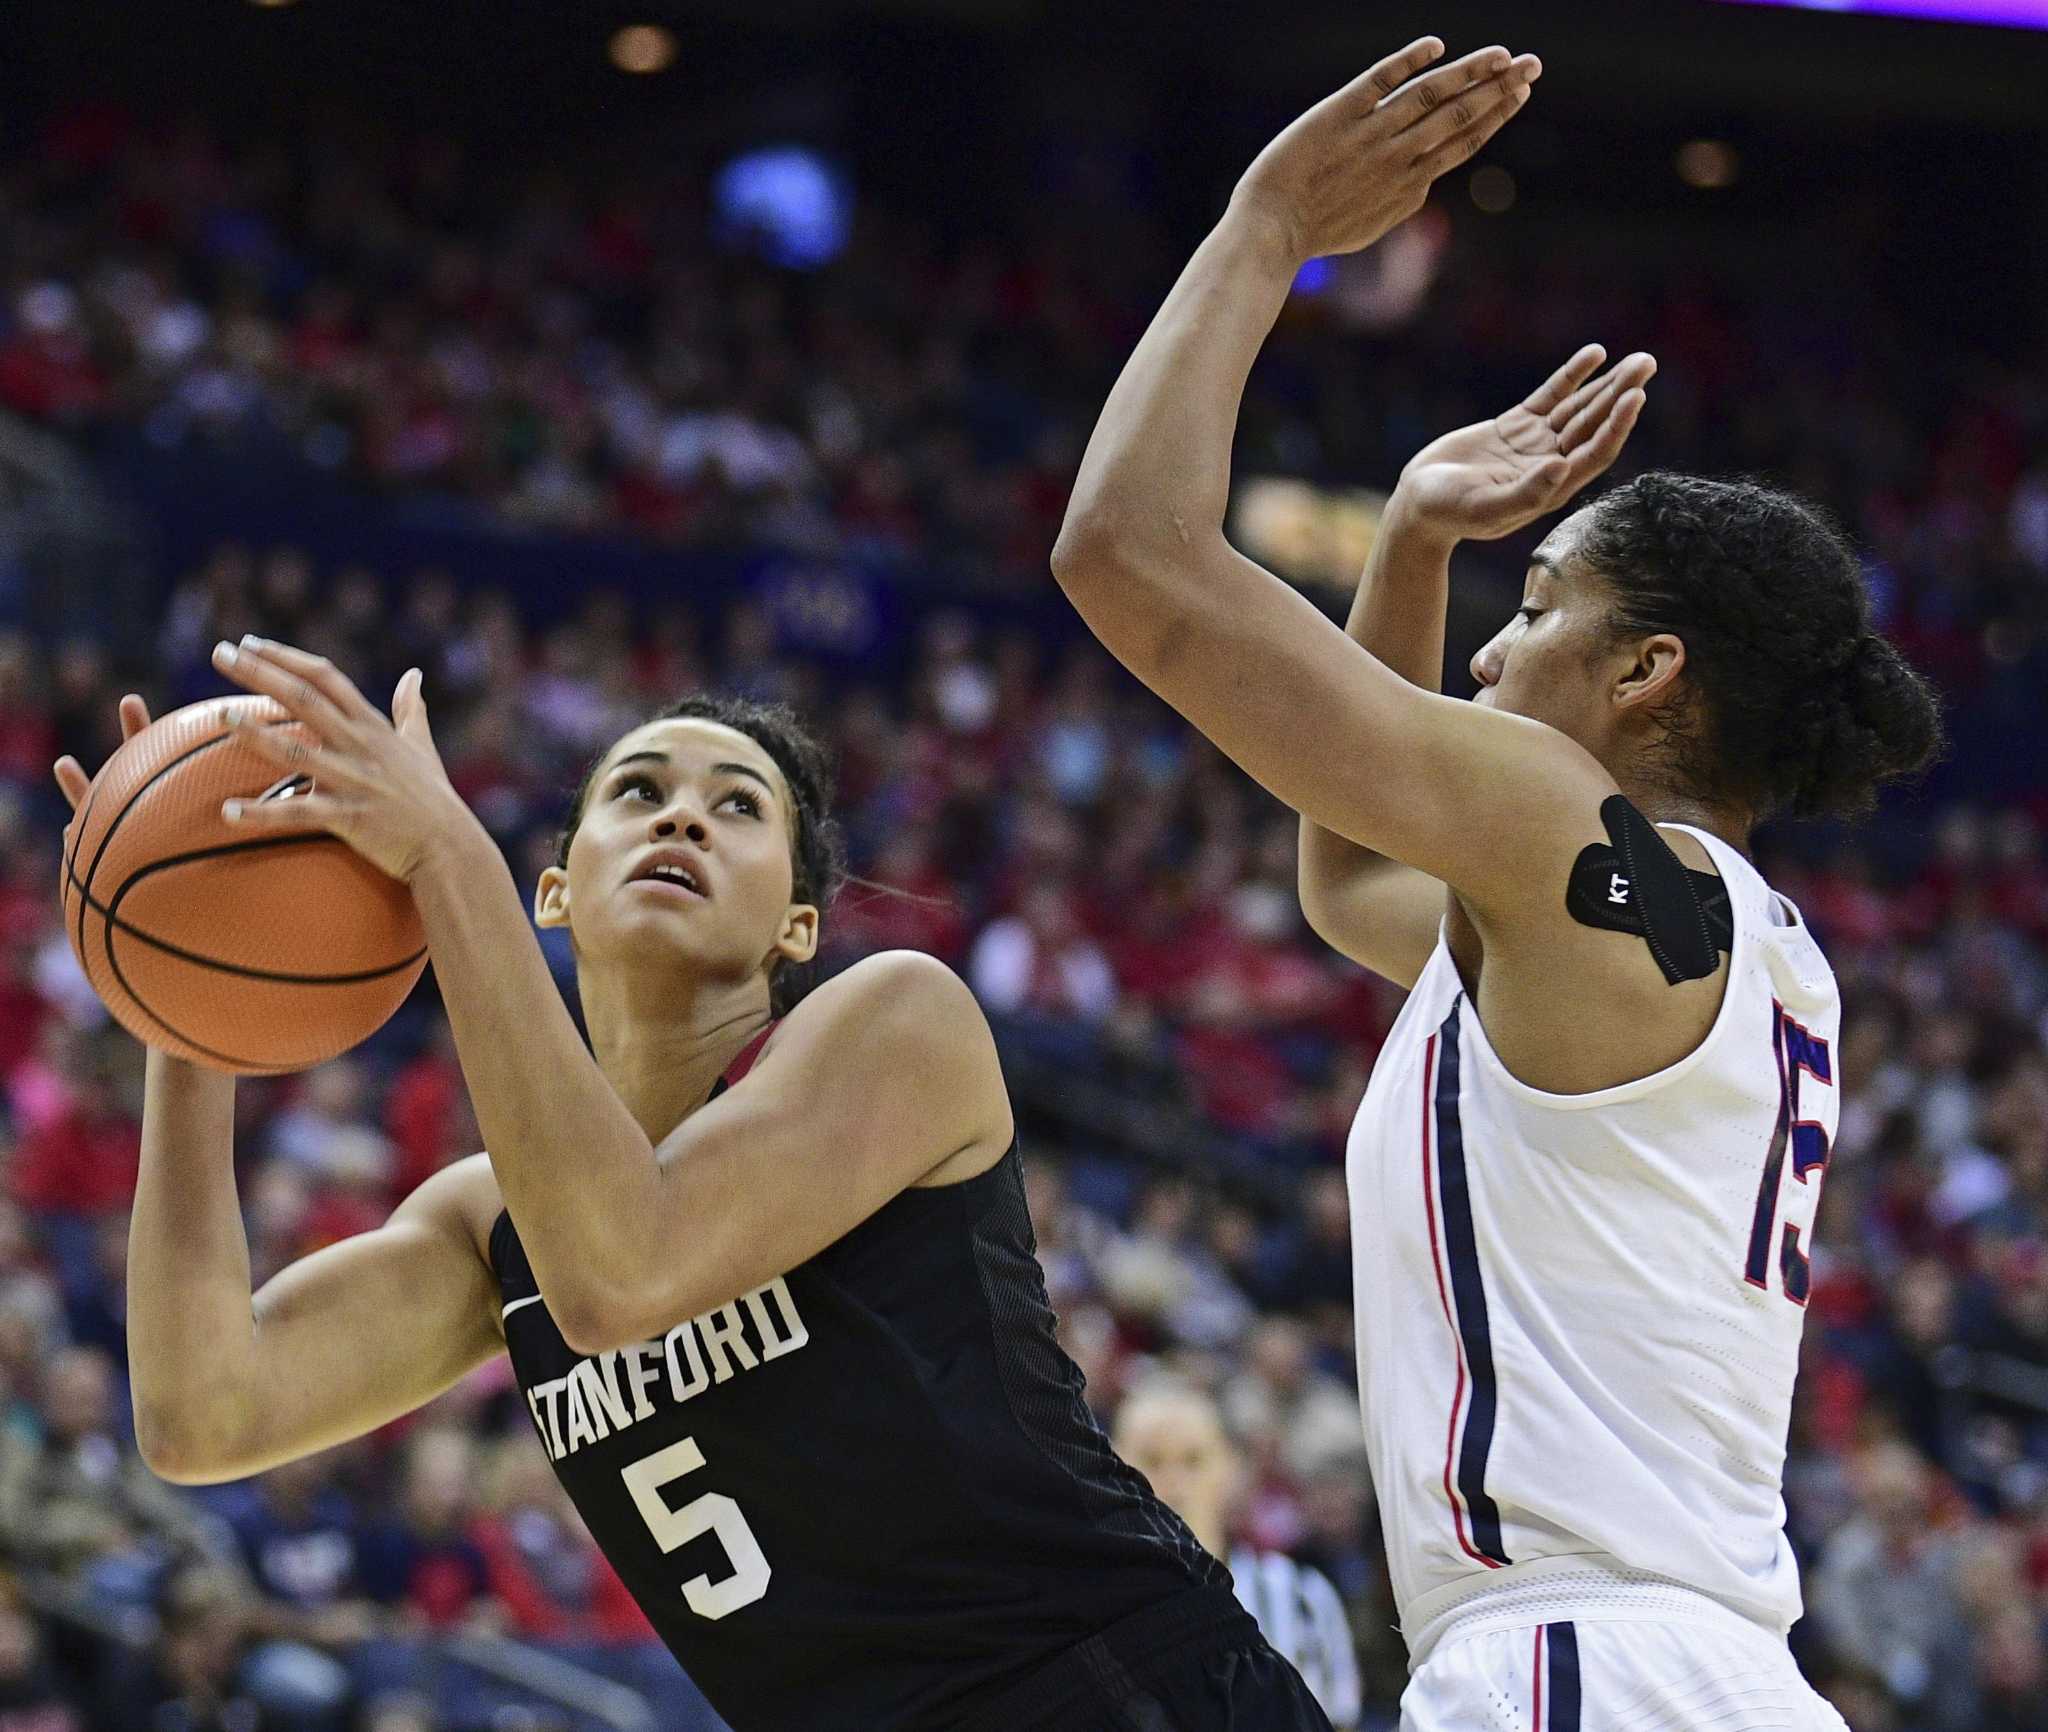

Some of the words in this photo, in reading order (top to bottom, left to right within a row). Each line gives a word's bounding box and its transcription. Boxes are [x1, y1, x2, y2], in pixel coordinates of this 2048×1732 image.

[1608, 873, 1630, 904] KT
[1744, 996, 1833, 1307] 15
[621, 1436, 772, 1621] 5
